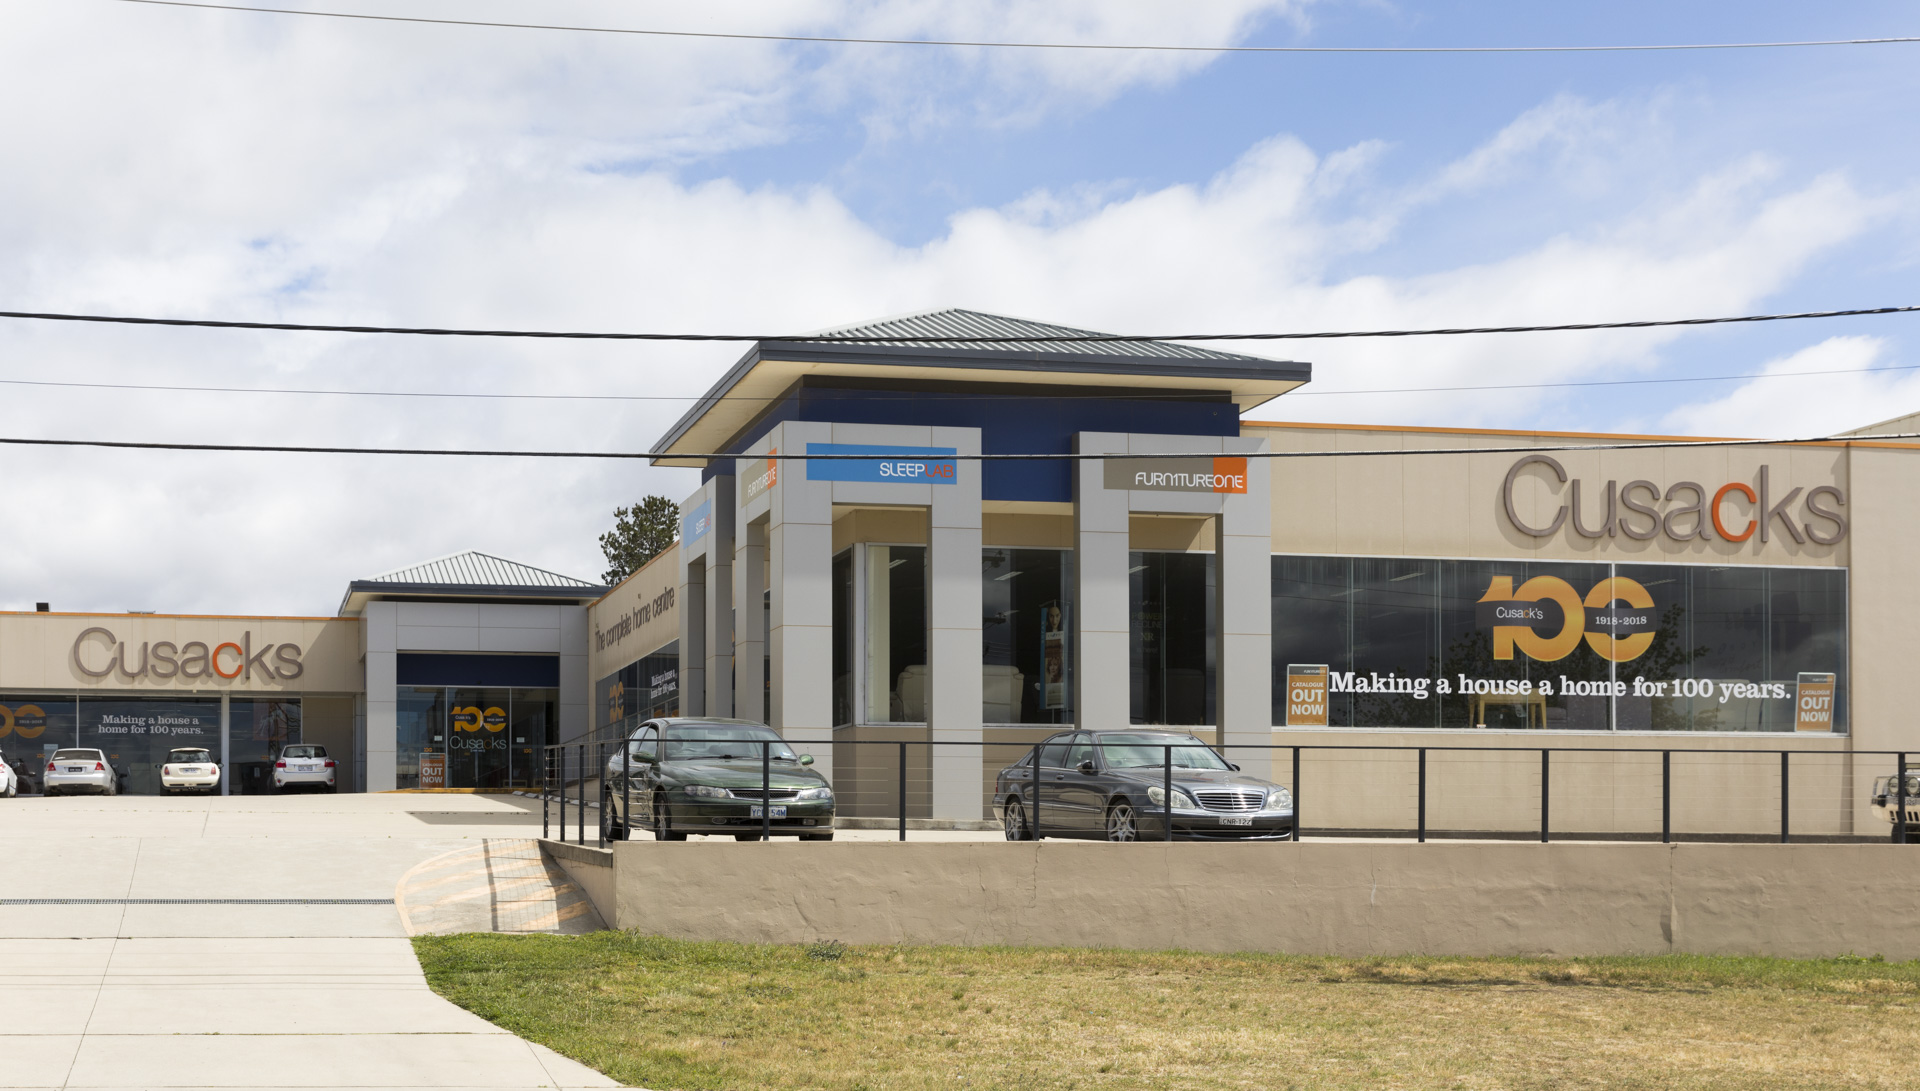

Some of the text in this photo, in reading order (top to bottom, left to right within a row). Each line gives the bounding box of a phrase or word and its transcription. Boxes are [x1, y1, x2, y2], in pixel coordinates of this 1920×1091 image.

[880, 462, 954, 478] SLEEPLAB
[1504, 454, 1847, 545] Cusacks
[595, 586, 675, 652] The complete home centre
[1496, 607, 1544, 619] Cusack's
[1595, 616, 1647, 625] 1918-2018
[73, 627, 304, 679] Cusacks
[1329, 671, 1791, 703] Making a house a home for 100 years.
[1292, 689, 1324, 702] OUT
[1291, 704, 1324, 715] NOW
[1801, 697, 1830, 710] OUT
[102, 715, 146, 726] Making
[158, 716, 190, 724] house
[1800, 711, 1830, 722] NOW
[98, 725, 204, 736] home for 100 years.
[450, 736, 507, 749] Cusacks
[422, 767, 443, 776] OUT
